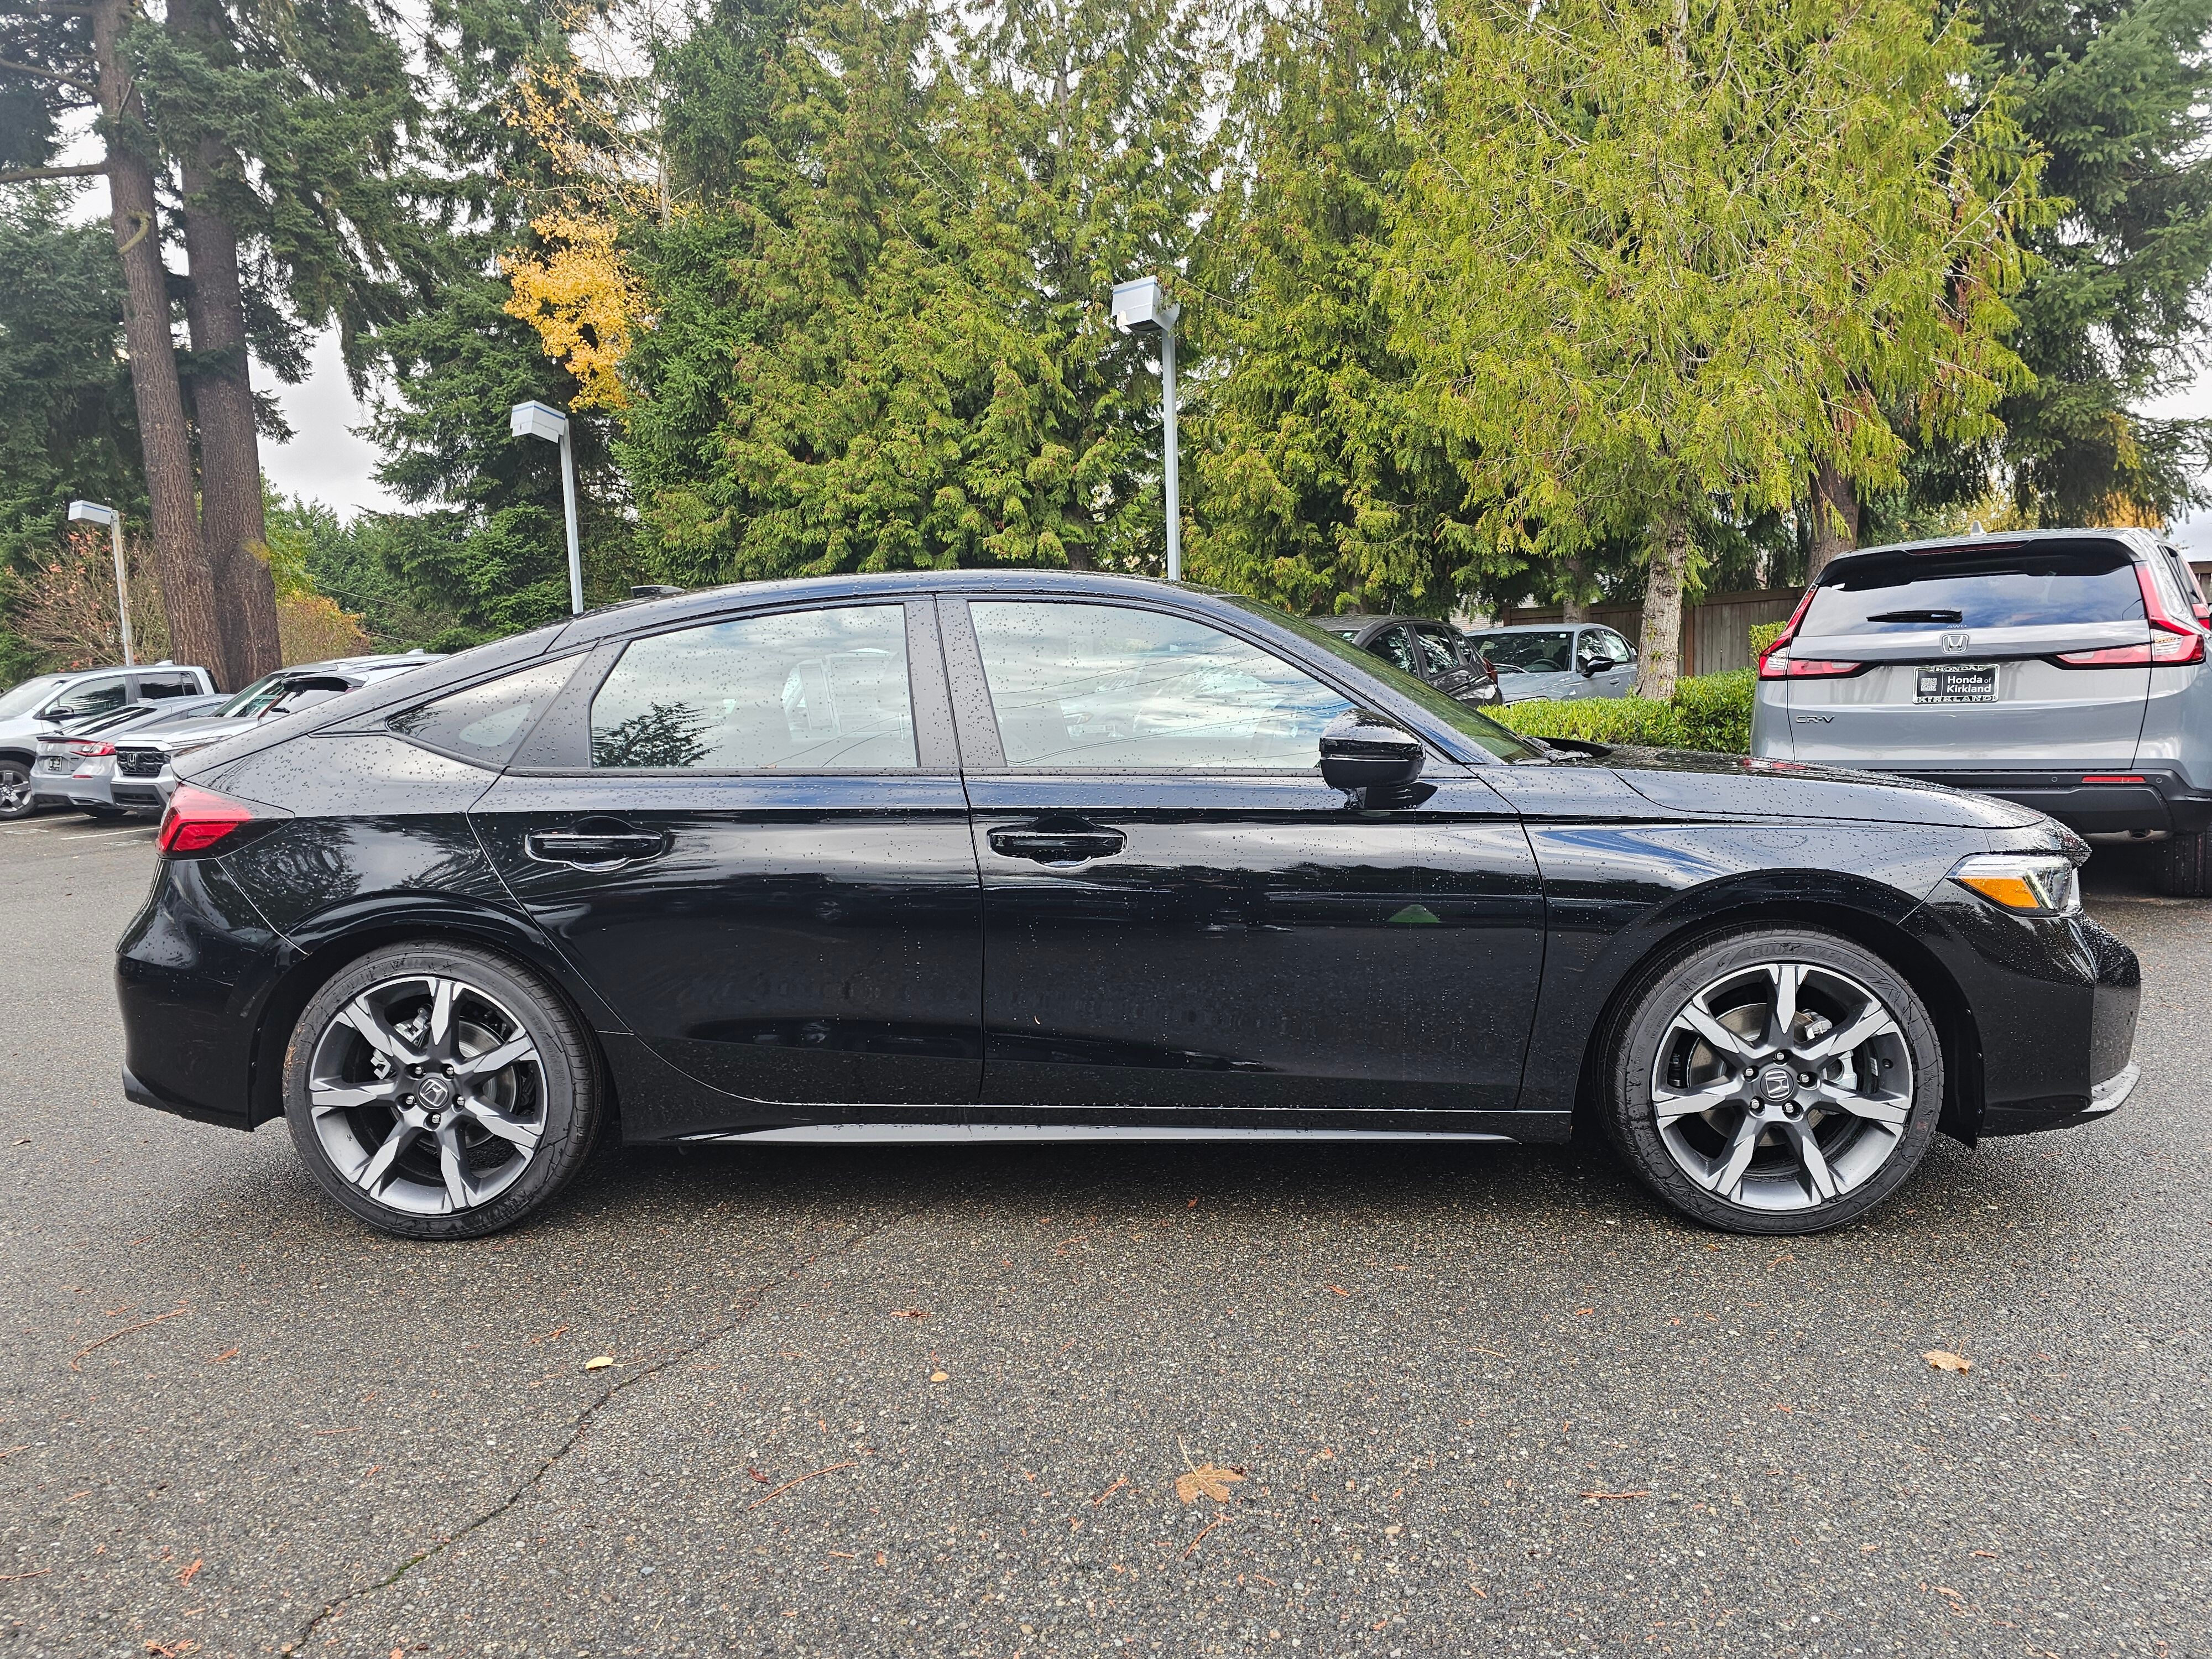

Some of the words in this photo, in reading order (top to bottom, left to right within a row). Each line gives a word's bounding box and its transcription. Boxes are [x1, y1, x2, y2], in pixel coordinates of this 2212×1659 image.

[1947, 675, 1983, 684] Honda
[1947, 684, 1991, 693] Kirkland
[1796, 715, 1835, 723] CR-V
